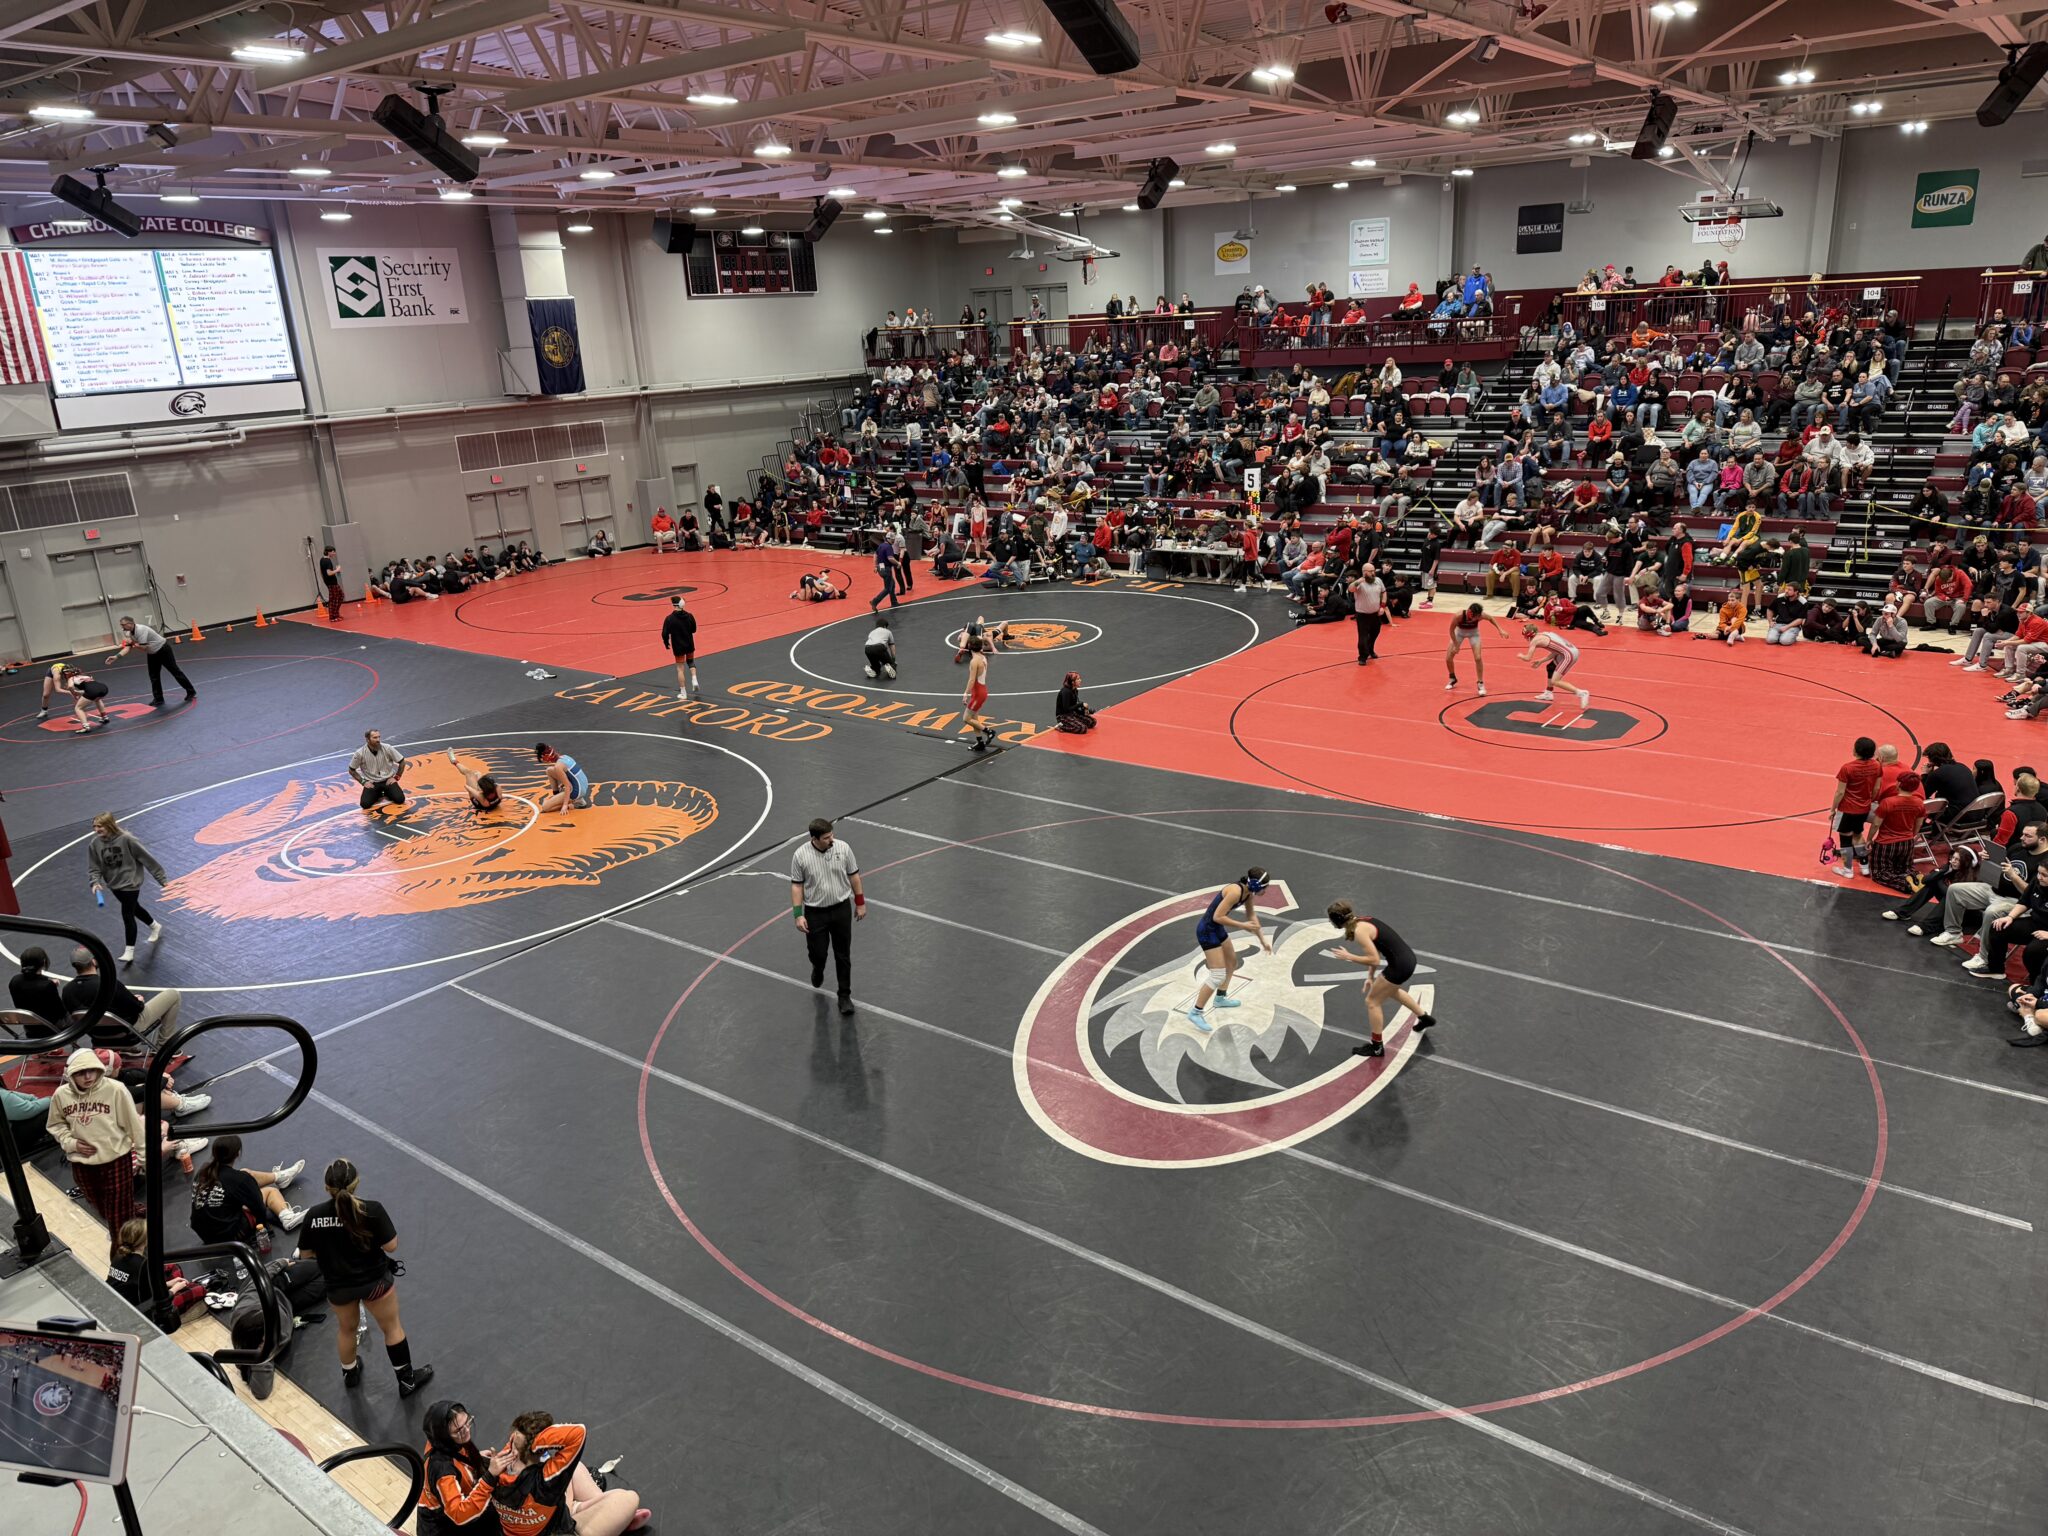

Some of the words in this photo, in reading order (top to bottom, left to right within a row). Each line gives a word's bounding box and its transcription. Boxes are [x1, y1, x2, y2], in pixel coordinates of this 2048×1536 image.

[1923, 192, 1965, 207] RUNZA
[29, 218, 112, 239] CHADRO
[140, 217, 178, 232] TATE
[181, 218, 256, 240] COLLEGE
[1543, 223, 1557, 231] DAY
[1697, 228, 1741, 237] FOUNDATION
[381, 255, 451, 282] Security
[385, 277, 424, 297] First
[1867, 289, 1879, 298] 104
[2017, 282, 2031, 292] 105
[389, 296, 436, 318] Bank
[1247, 473, 1255, 488] 5
[62, 1101, 111, 1118] BEARCATS
[310, 1216, 344, 1229] ARELL
